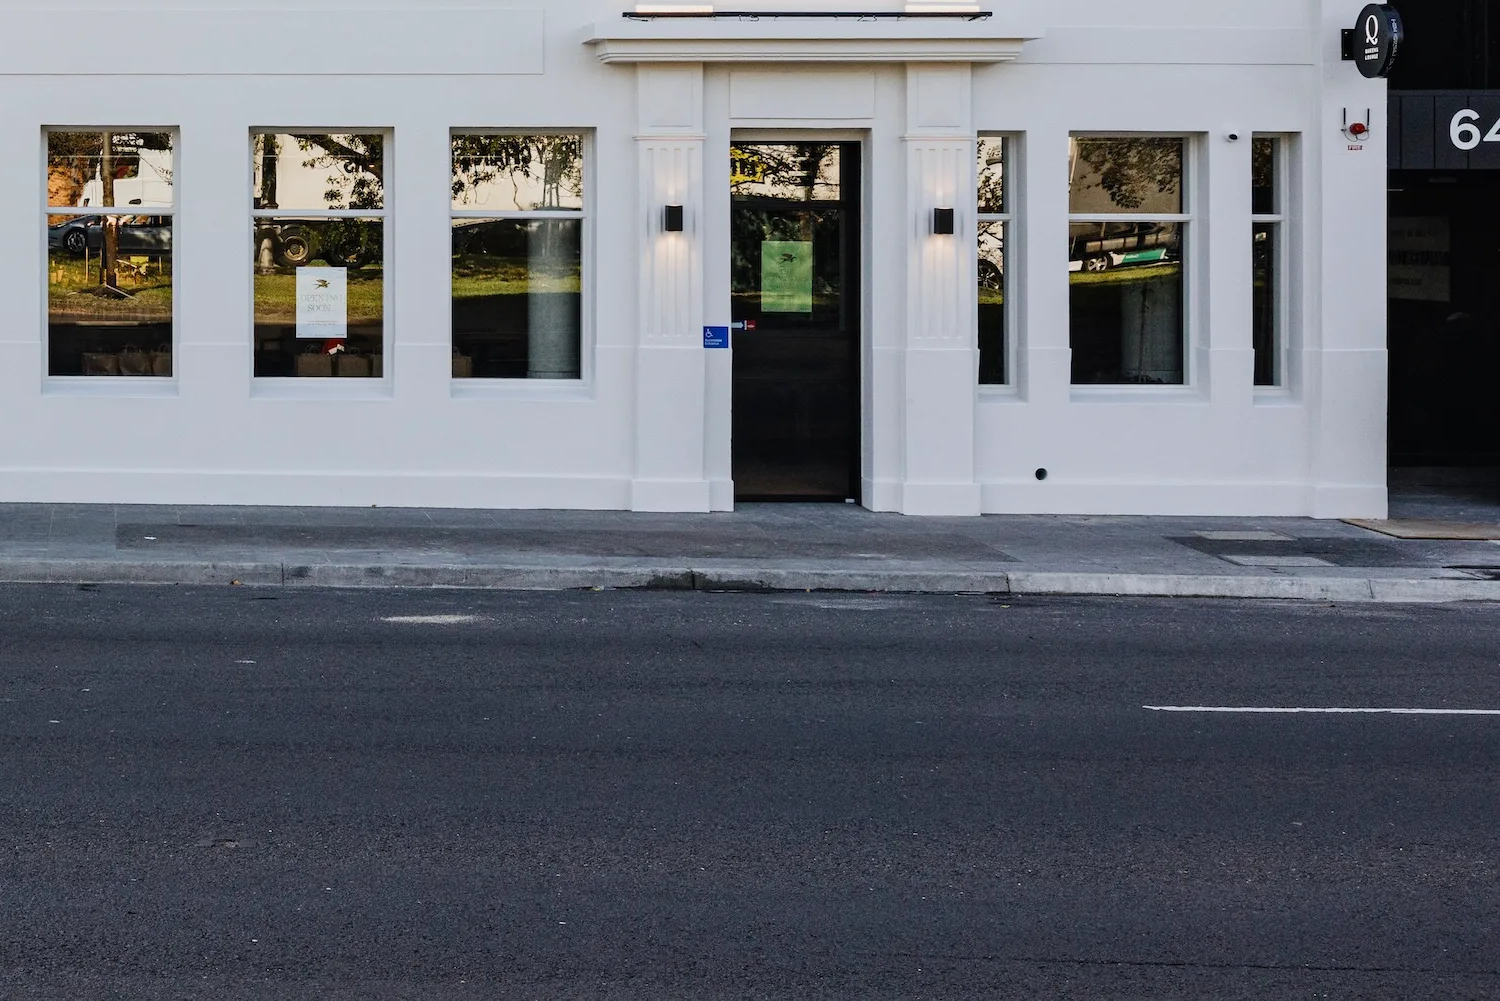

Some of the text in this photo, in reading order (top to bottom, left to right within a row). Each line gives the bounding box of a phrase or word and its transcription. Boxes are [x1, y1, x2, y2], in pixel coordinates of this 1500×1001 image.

[1365, 14, 1378, 46] Q
[1364, 47, 1379, 55] QUEENS
[300, 294, 342, 302] OPENING
